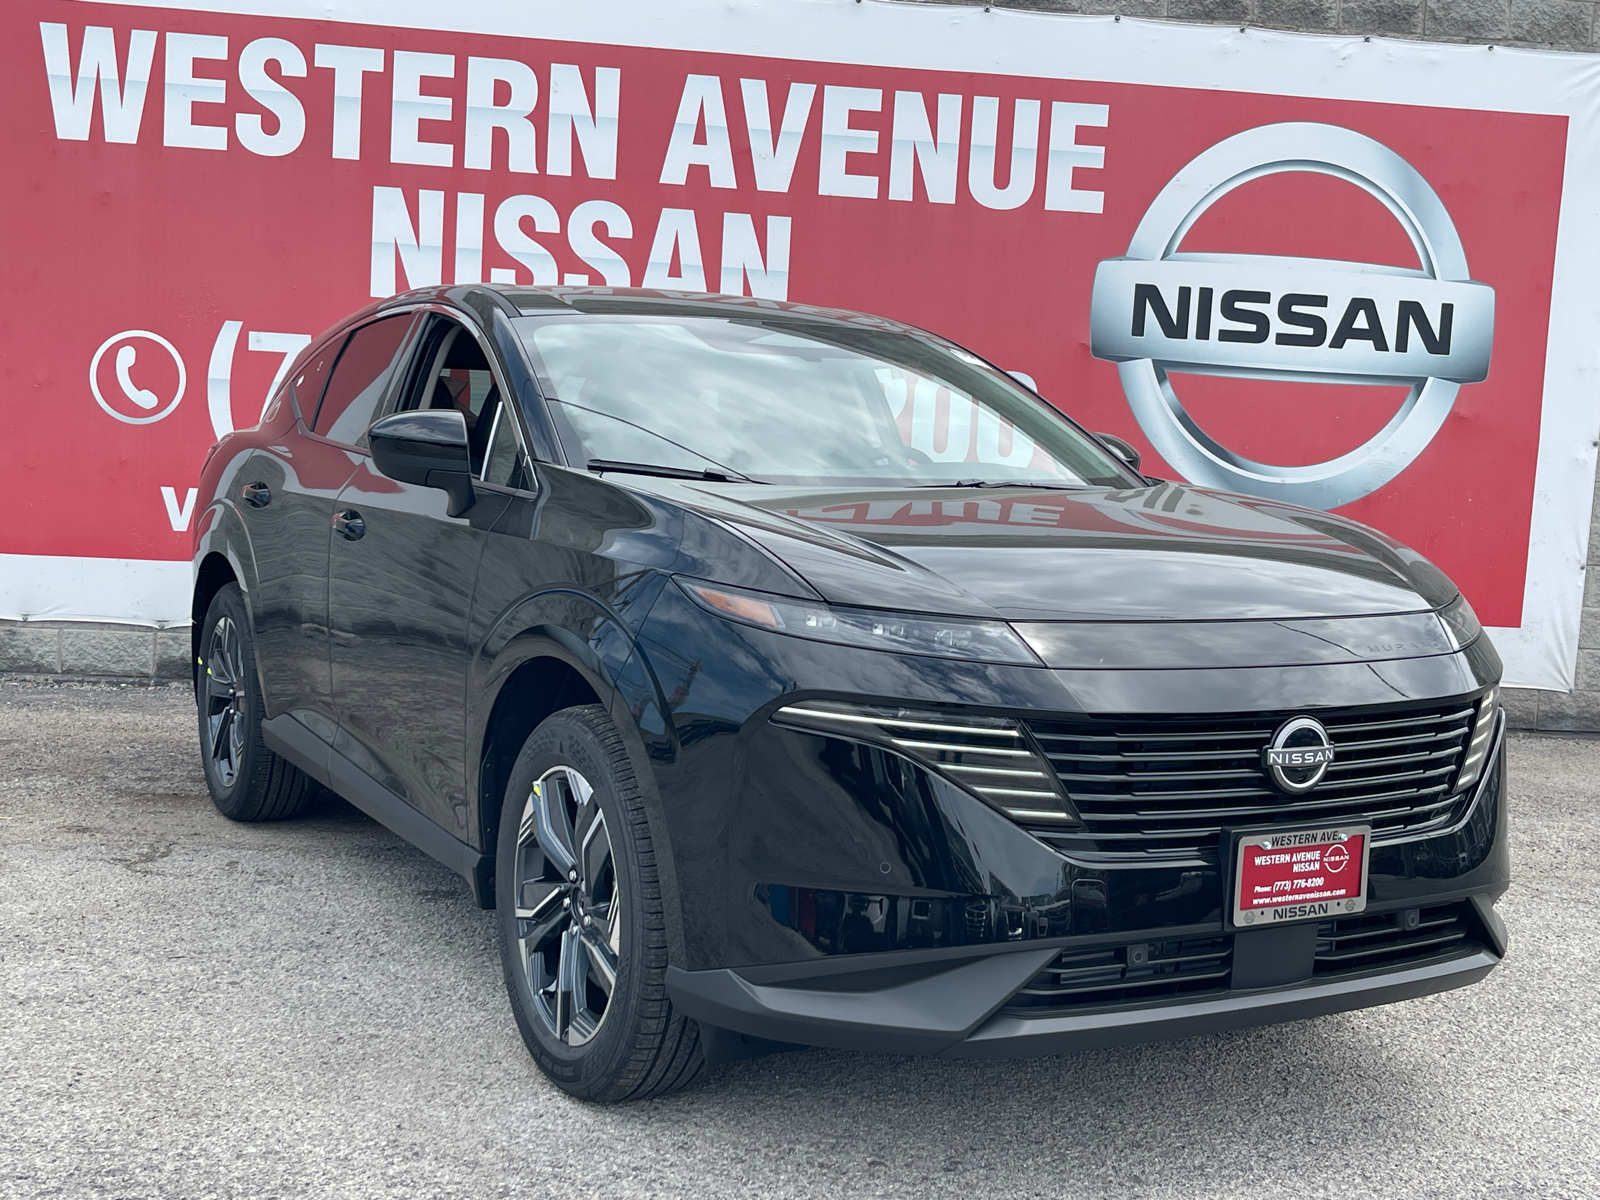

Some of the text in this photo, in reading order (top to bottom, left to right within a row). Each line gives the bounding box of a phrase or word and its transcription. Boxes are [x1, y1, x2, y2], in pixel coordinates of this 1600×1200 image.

[40, 22, 1109, 213] WESTERN AVENUE
[370, 186, 792, 302] NISSAN
[1131, 284, 1454, 355] NISSAN
[1269, 748, 1333, 764] NISSAN
[1271, 832, 1318, 847] WESTERN
[1254, 850, 1321, 866] WESTERN AVENUE
[1323, 854, 1349, 862] NISSAN
[1293, 861, 1320, 873] NISSAN
[1272, 880, 1292, 893] (773)
[1293, 877, 1325, 889] 776-8200
[1252, 888, 1346, 905] www.westernavenissan.com
[1273, 903, 1328, 920] NISSAN
